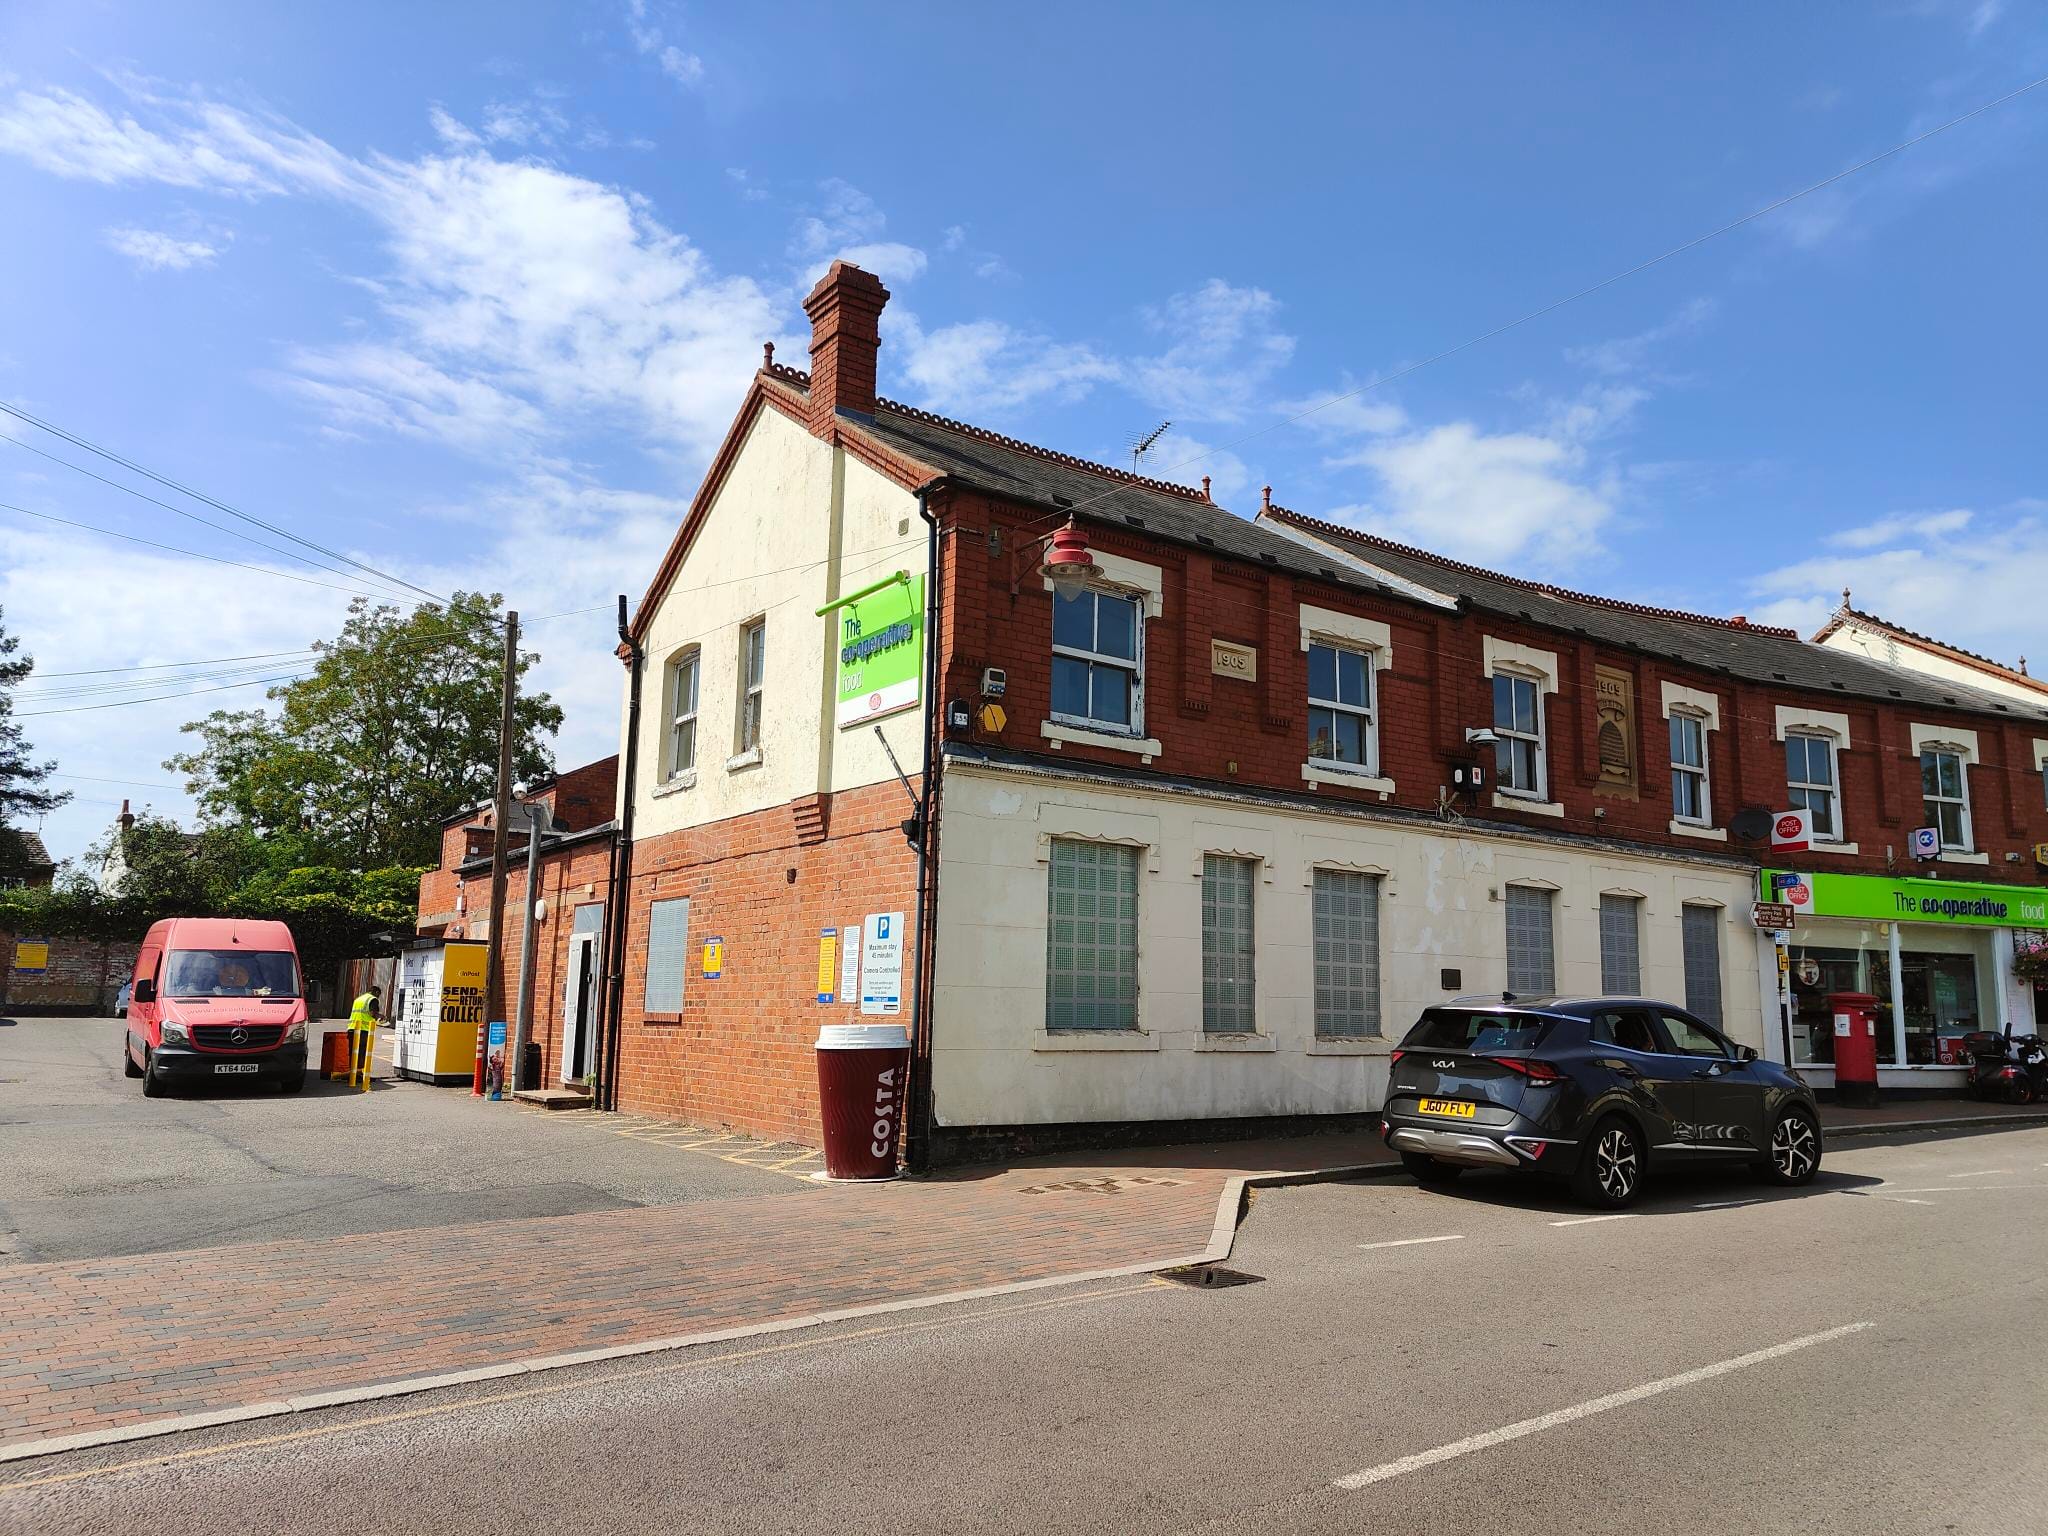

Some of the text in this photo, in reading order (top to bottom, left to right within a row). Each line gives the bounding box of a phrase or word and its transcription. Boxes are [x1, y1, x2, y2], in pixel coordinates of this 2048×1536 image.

[845, 618, 862, 640] The
[1216, 651, 1249, 670] 1905
[842, 666, 864, 694] food
[1778, 825, 1800, 835] OFFICE
[1781, 819, 1798, 828] POST
[1789, 892, 1809, 900] OFFICE
[1892, 891, 1917, 912] The
[2020, 900, 2046, 920] food
[880, 918, 889, 937] P
[888, 943, 898, 952] stay
[443, 986, 478, 996] SEND
[459, 995, 484, 1006] RETUR
[217, 1065, 239, 1073] KT64
[871, 1068, 895, 1158] COSTA
[1423, 1101, 1471, 1116] JG07 FLY
